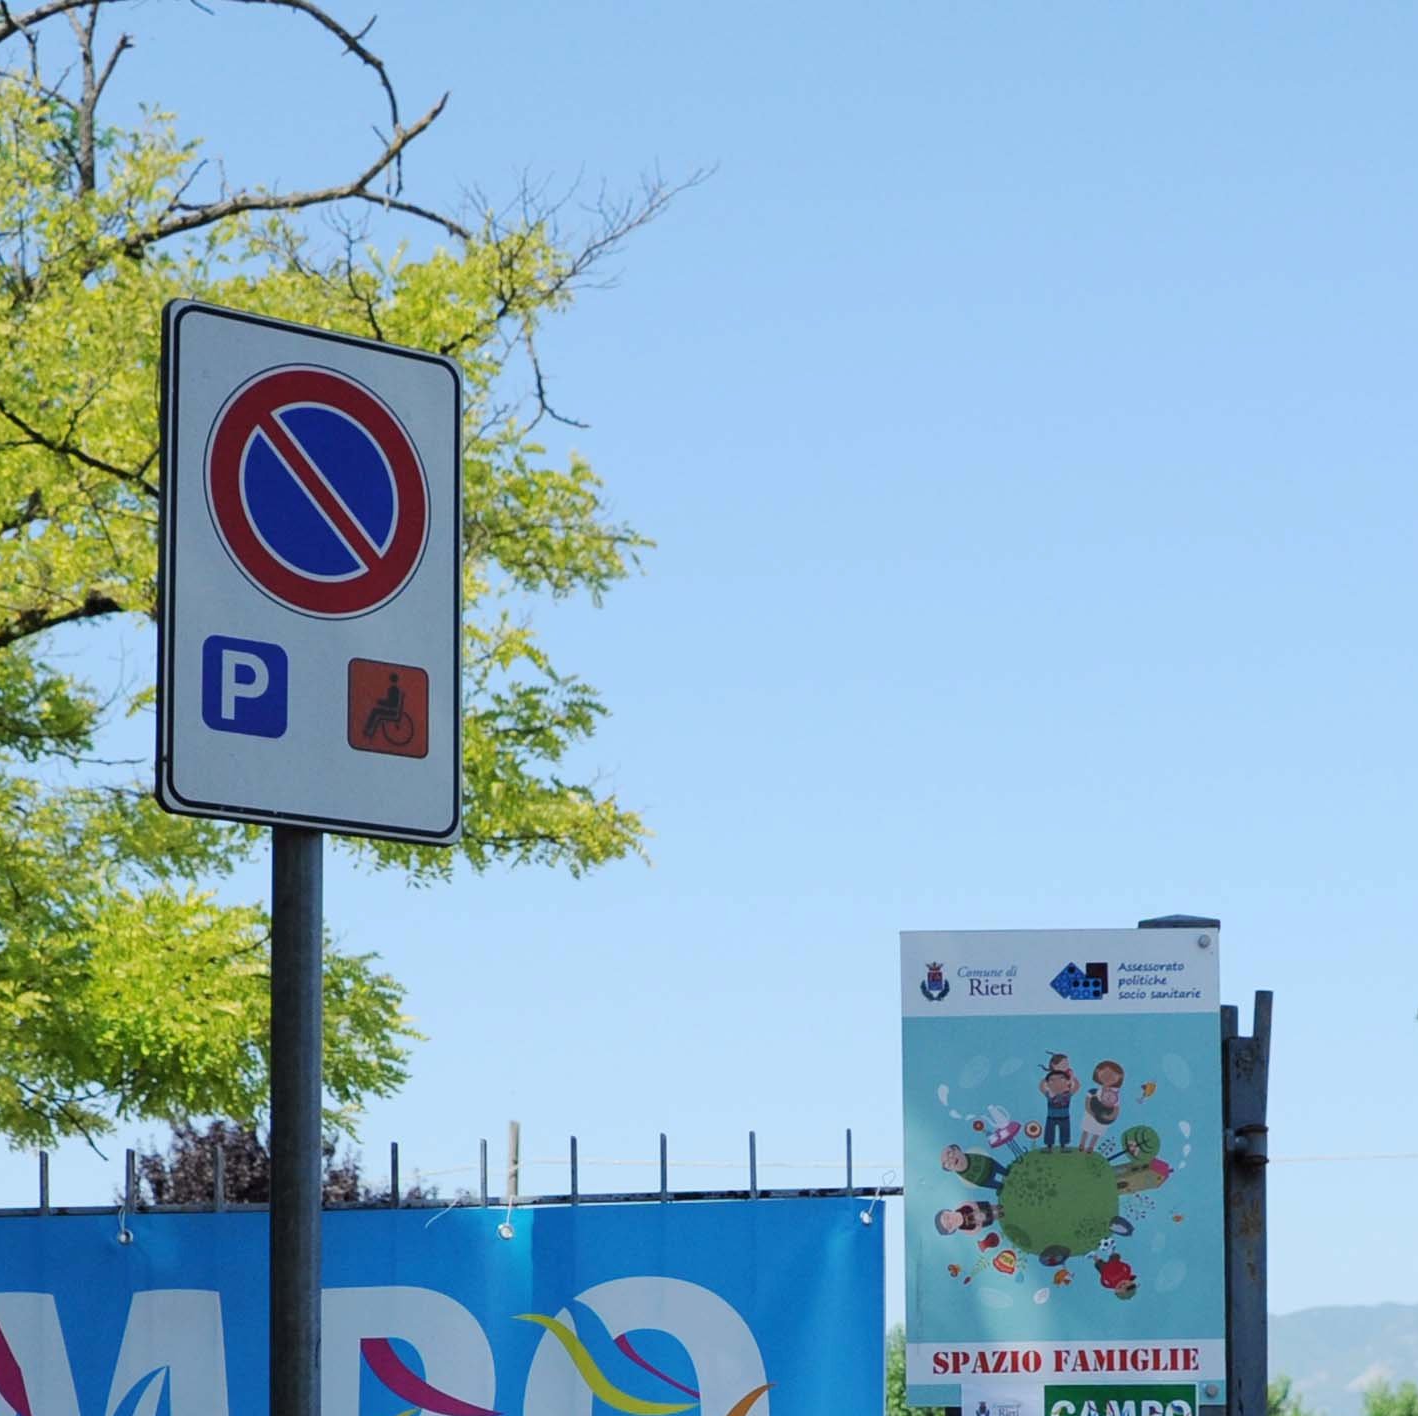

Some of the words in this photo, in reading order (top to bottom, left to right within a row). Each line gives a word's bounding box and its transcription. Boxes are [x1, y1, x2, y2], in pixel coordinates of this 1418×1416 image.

[221, 649, 270, 720] P
[957, 966, 1002, 978] Comune
[1006, 965, 1018, 977] di
[1118, 962, 1185, 972] Assessorato
[1118, 975, 1167, 986] politiche
[969, 979, 1013, 996] Rieti
[1118, 990, 1147, 999] socio
[1150, 989, 1202, 999] sanitarie
[932, 1349, 1043, 1375] SPAZIO
[1053, 1348, 1200, 1373] FAMIGLIE
